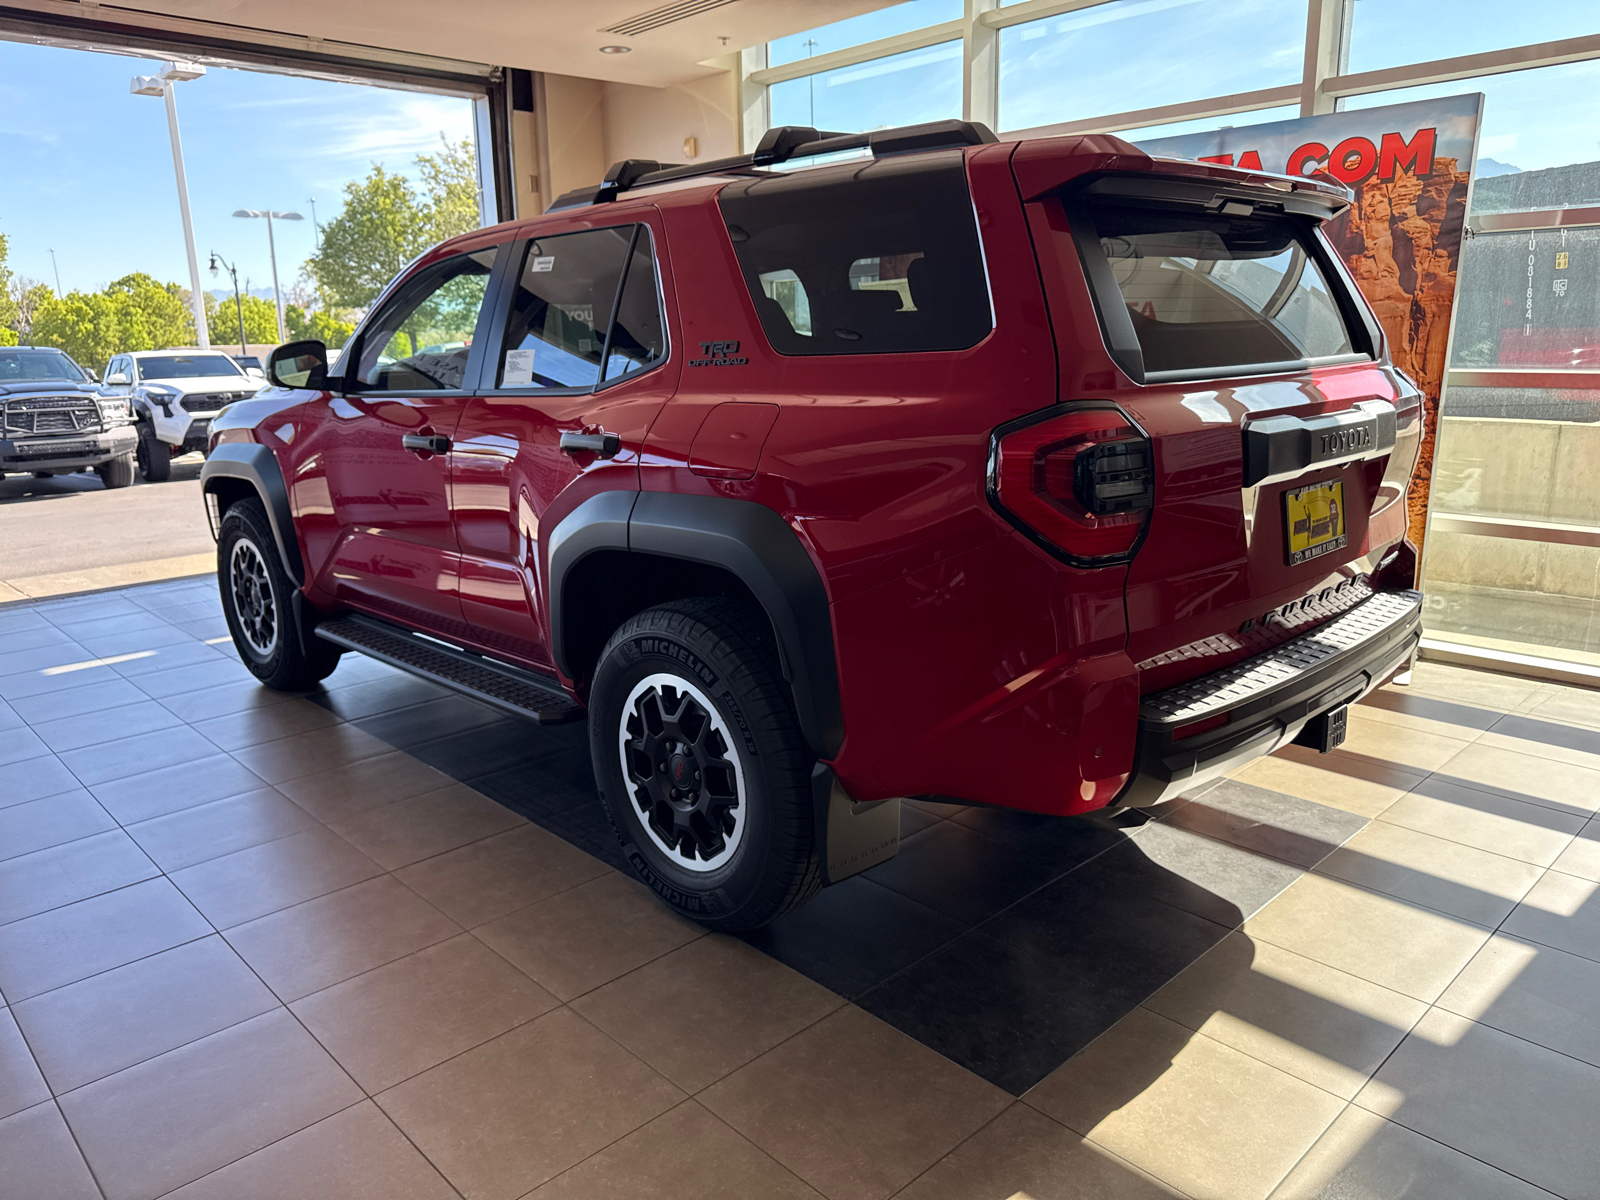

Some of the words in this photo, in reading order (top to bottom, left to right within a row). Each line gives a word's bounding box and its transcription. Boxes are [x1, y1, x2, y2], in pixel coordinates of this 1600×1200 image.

[688, 359, 711, 367] OFF
[712, 357, 749, 366] ROAD
[699, 340, 741, 358] TRD
[1320, 425, 1372, 455] TOYOTA
[641, 639, 715, 684] MICHELIN
[723, 693, 746, 729] 265/70
[631, 856, 700, 911] MICHELIN
